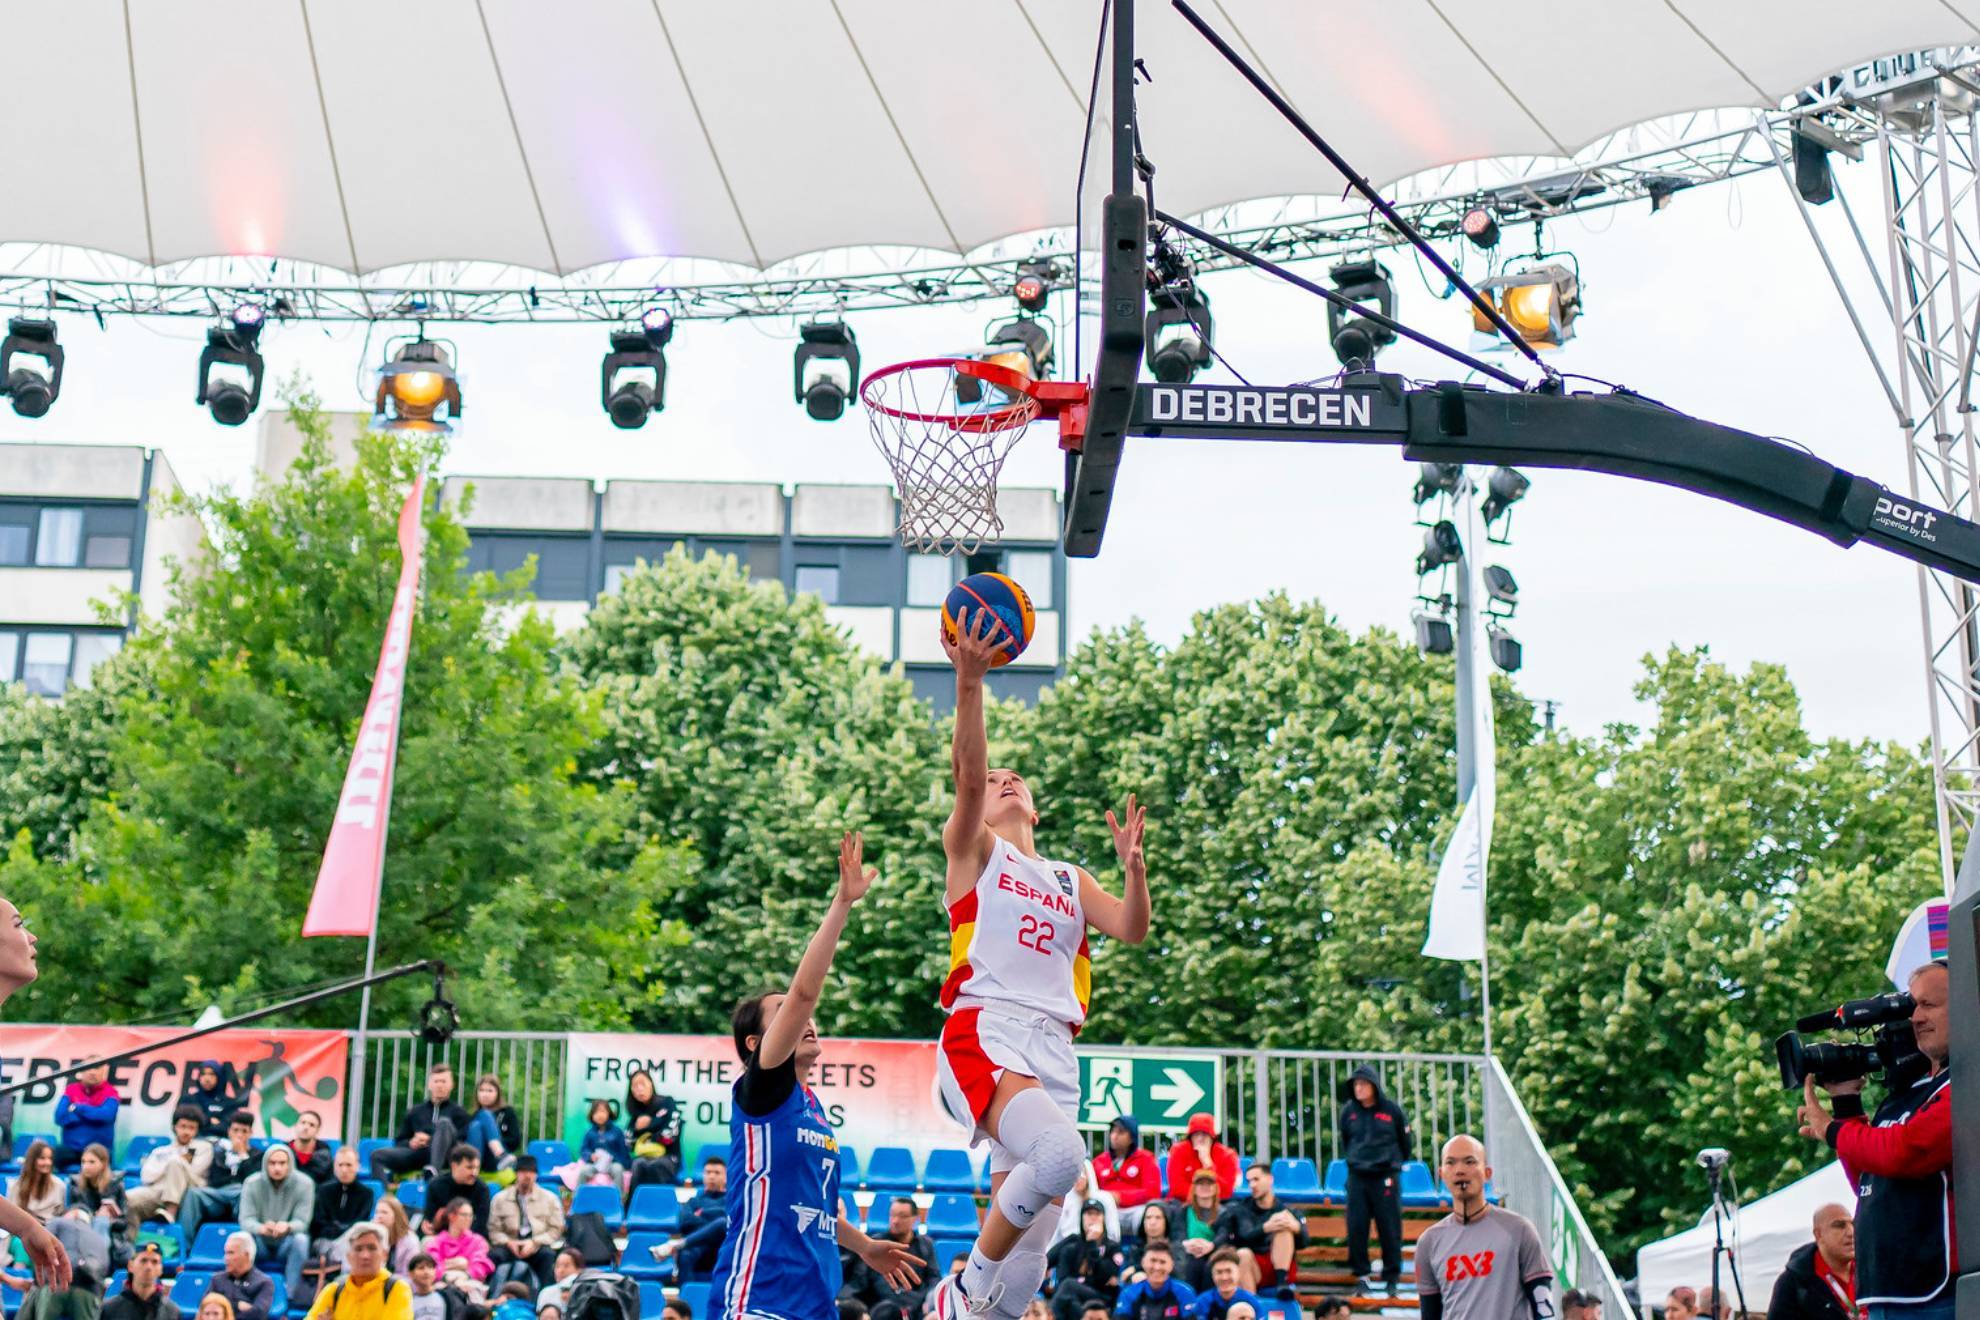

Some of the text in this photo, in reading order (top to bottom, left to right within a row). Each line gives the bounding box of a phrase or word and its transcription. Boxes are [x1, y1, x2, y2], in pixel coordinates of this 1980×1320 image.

[1152, 388, 1371, 426] DEBRECEN
[1876, 516, 1909, 531] uperior
[1910, 526, 1920, 537] by
[1018, 914, 1054, 956] 22
[585, 1057, 666, 1082] FROM
[677, 1059, 733, 1084] THE
[822, 1157, 835, 1199] 7
